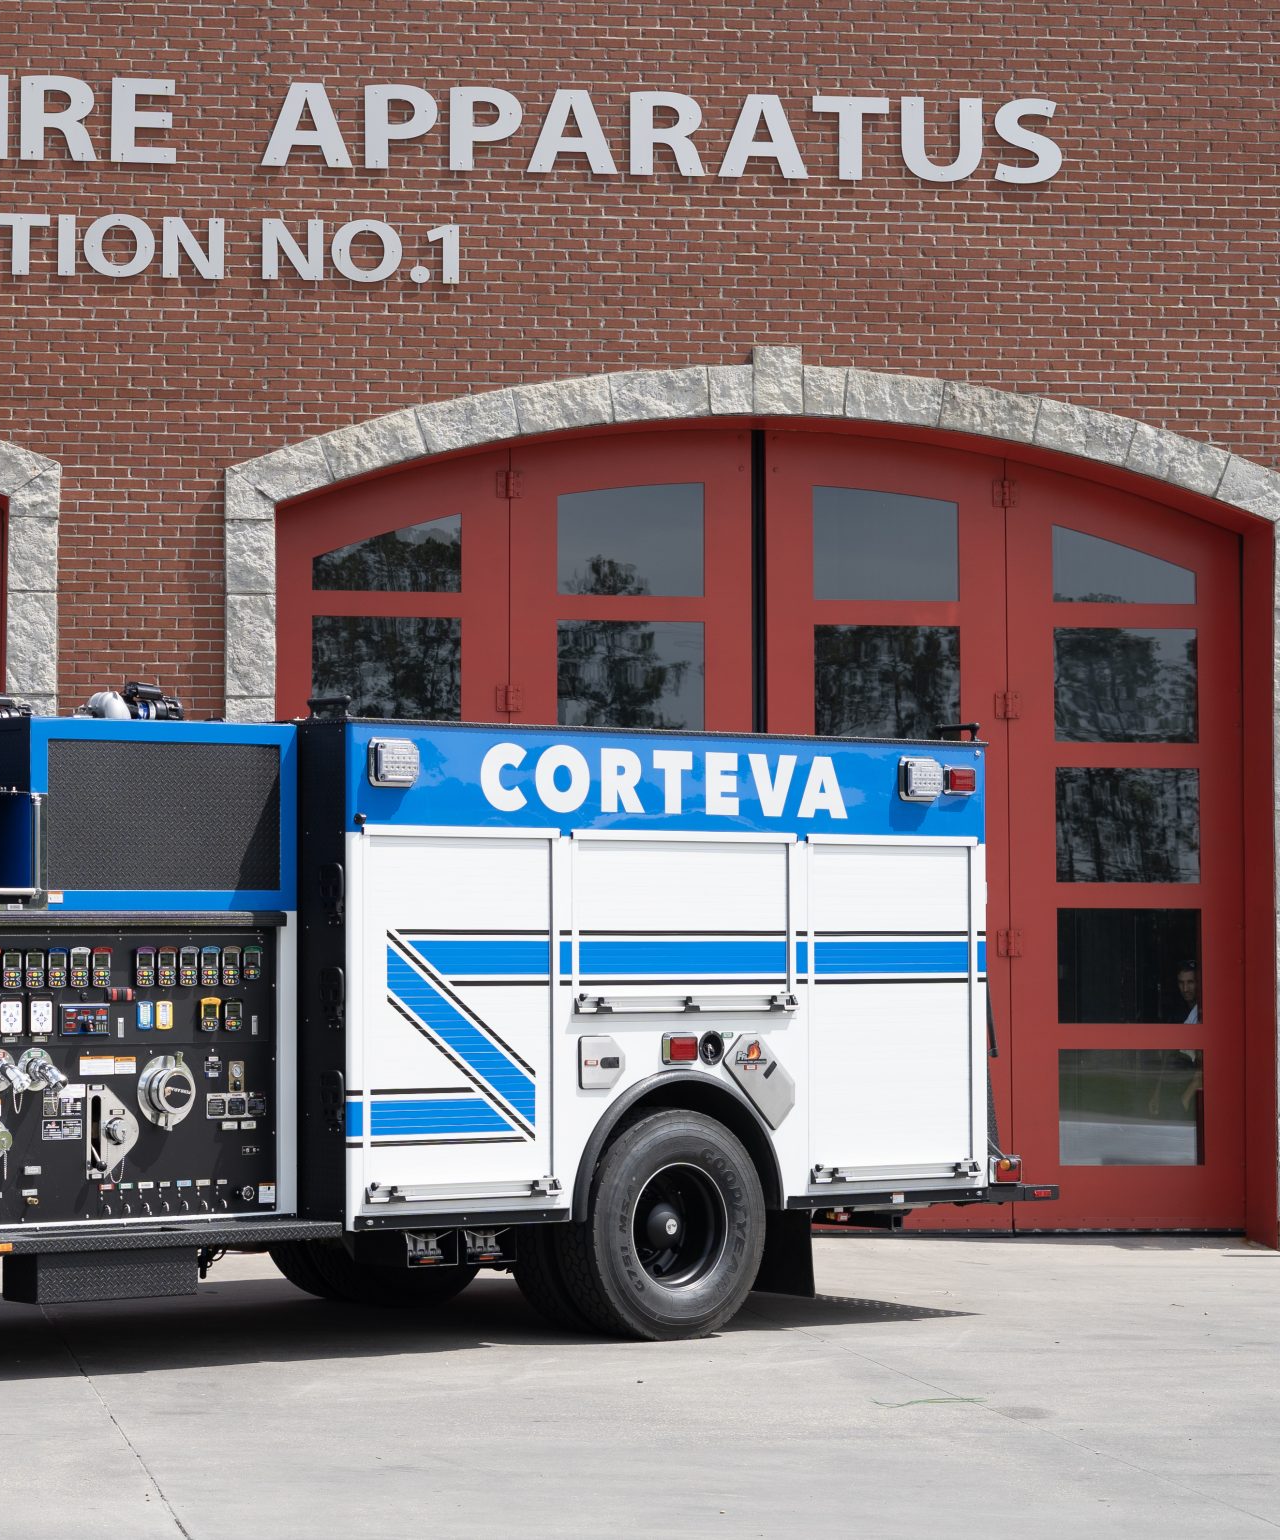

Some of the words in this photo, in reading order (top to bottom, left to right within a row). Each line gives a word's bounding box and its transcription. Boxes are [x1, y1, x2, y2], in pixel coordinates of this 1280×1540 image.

[261, 82, 1064, 185] APPARATUS
[262, 217, 461, 285] NO.1
[480, 742, 849, 819] CORTEVA
[700, 1149, 747, 1293] GOODYEAR
